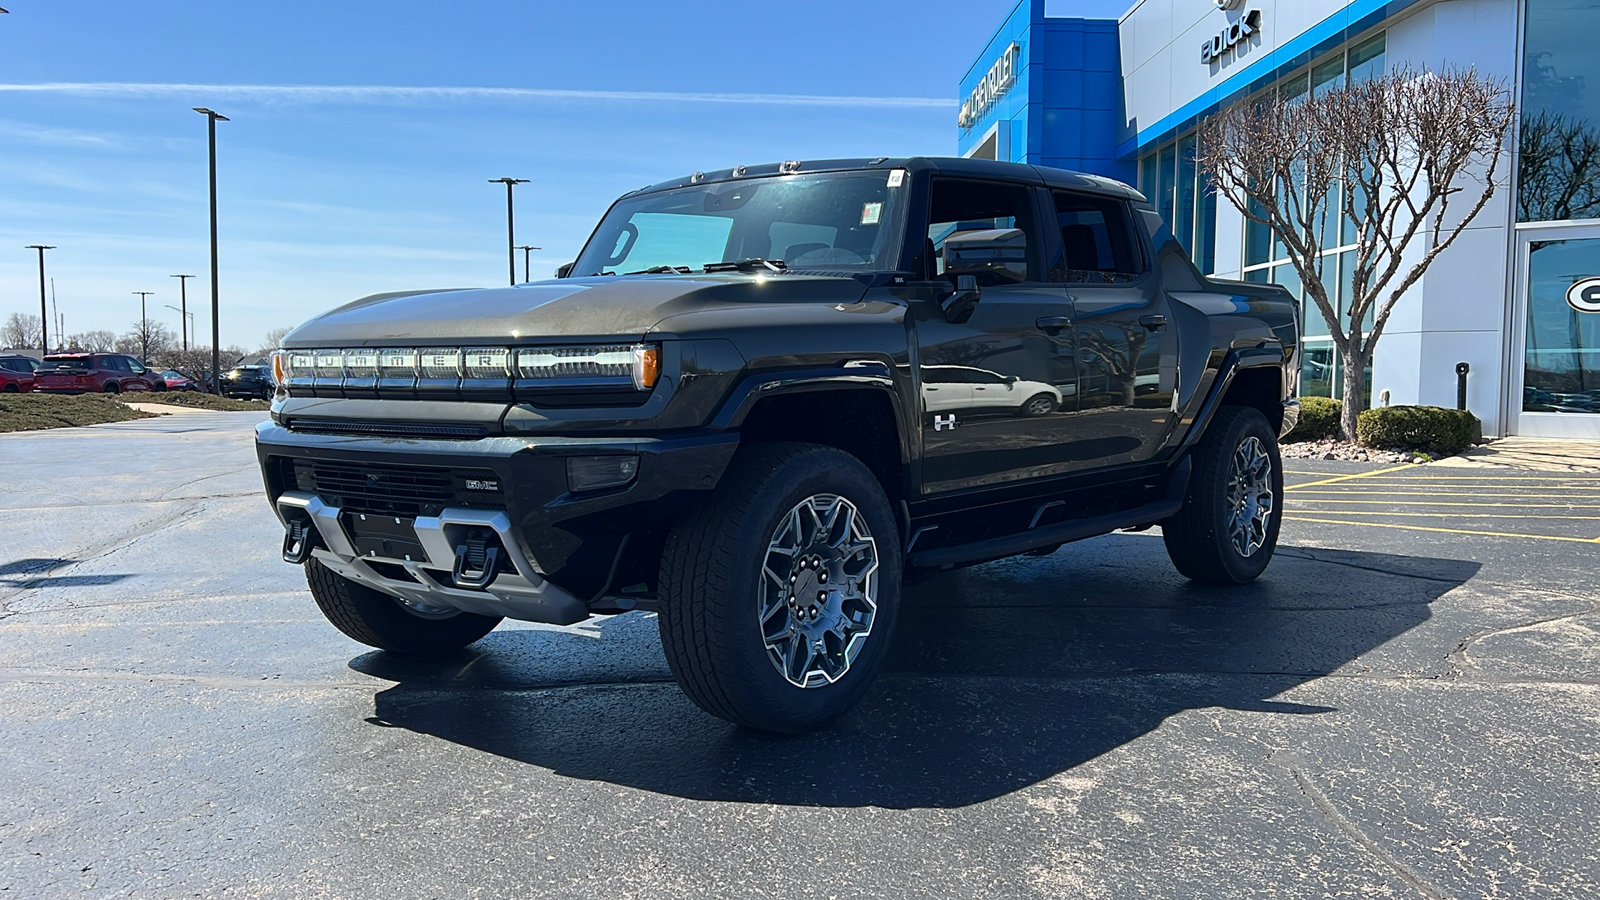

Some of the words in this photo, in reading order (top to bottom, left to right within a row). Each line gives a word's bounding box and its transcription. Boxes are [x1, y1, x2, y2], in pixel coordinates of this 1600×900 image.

[1200, 10, 1260, 64] BUICK
[971, 41, 1018, 118] CHEVROLET
[299, 356, 492, 367] HUMMER
[465, 479, 498, 491] GMC
